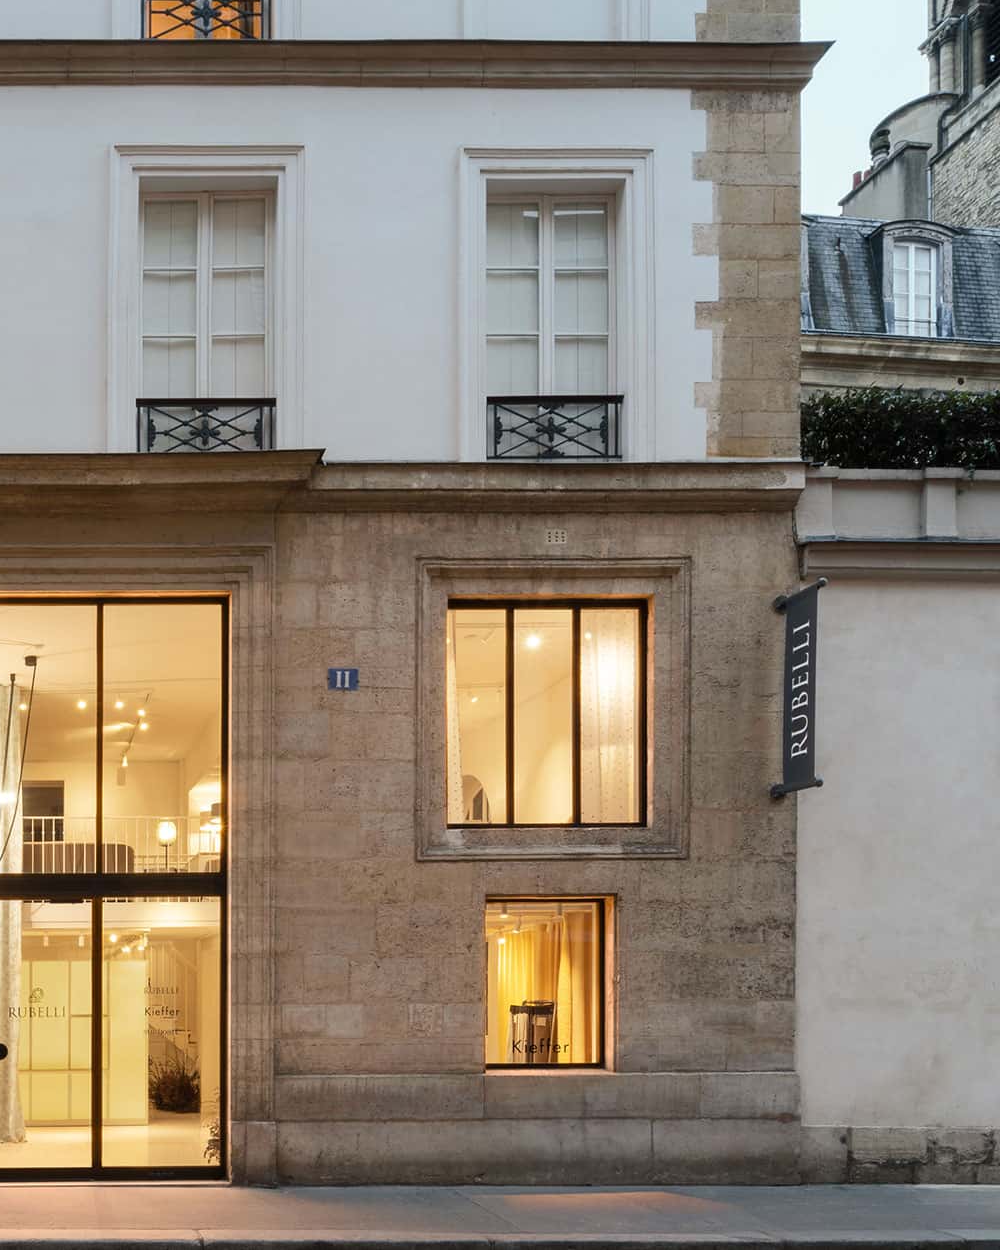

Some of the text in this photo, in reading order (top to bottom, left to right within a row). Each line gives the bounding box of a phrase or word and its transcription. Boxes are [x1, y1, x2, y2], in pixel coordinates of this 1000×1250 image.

[336, 670, 350, 688] 11
[791, 619, 810, 758] RUBELLI
[8, 1006, 65, 1018] RUBELLI
[144, 1005, 179, 1016] Kieffer
[512, 1037, 569, 1053] Kieffer
